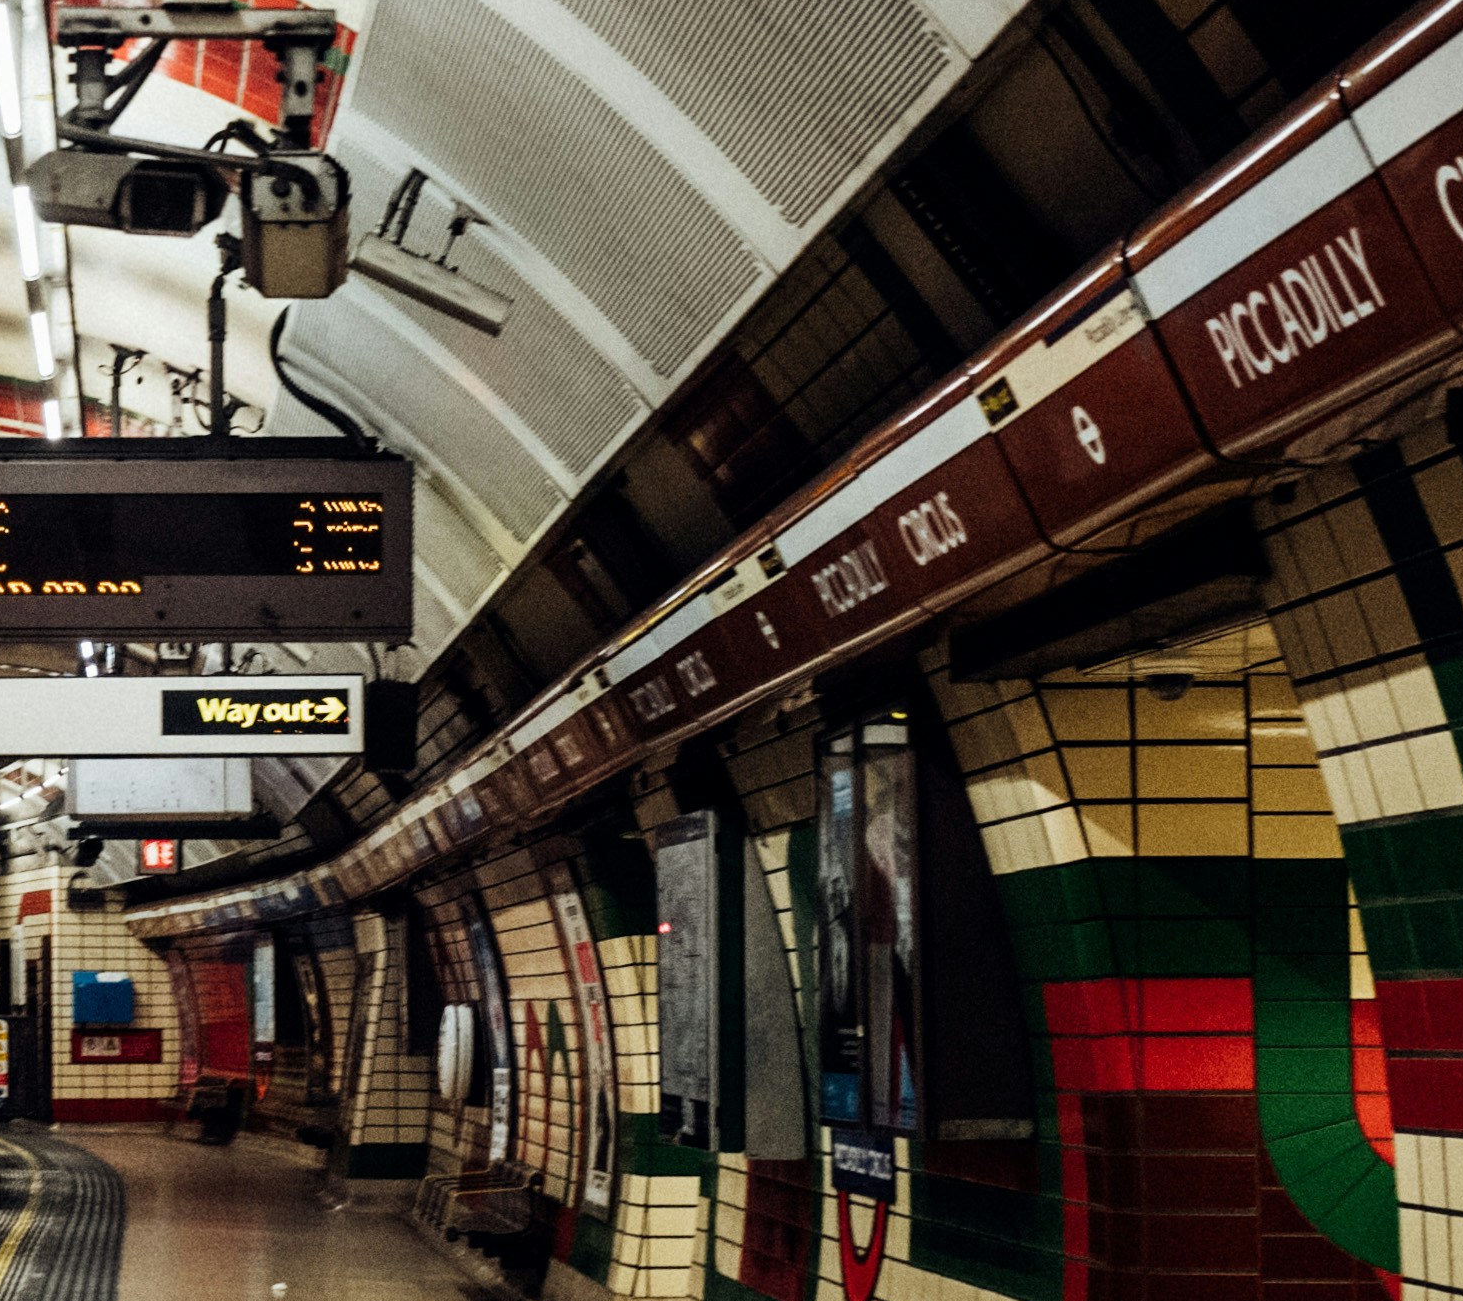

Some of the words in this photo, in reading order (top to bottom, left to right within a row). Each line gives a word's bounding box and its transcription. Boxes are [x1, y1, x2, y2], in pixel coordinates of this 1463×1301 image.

[1205, 226, 1386, 389] PICCADILLY
[197, 697, 260, 728] Way
[262, 698, 316, 723] out
